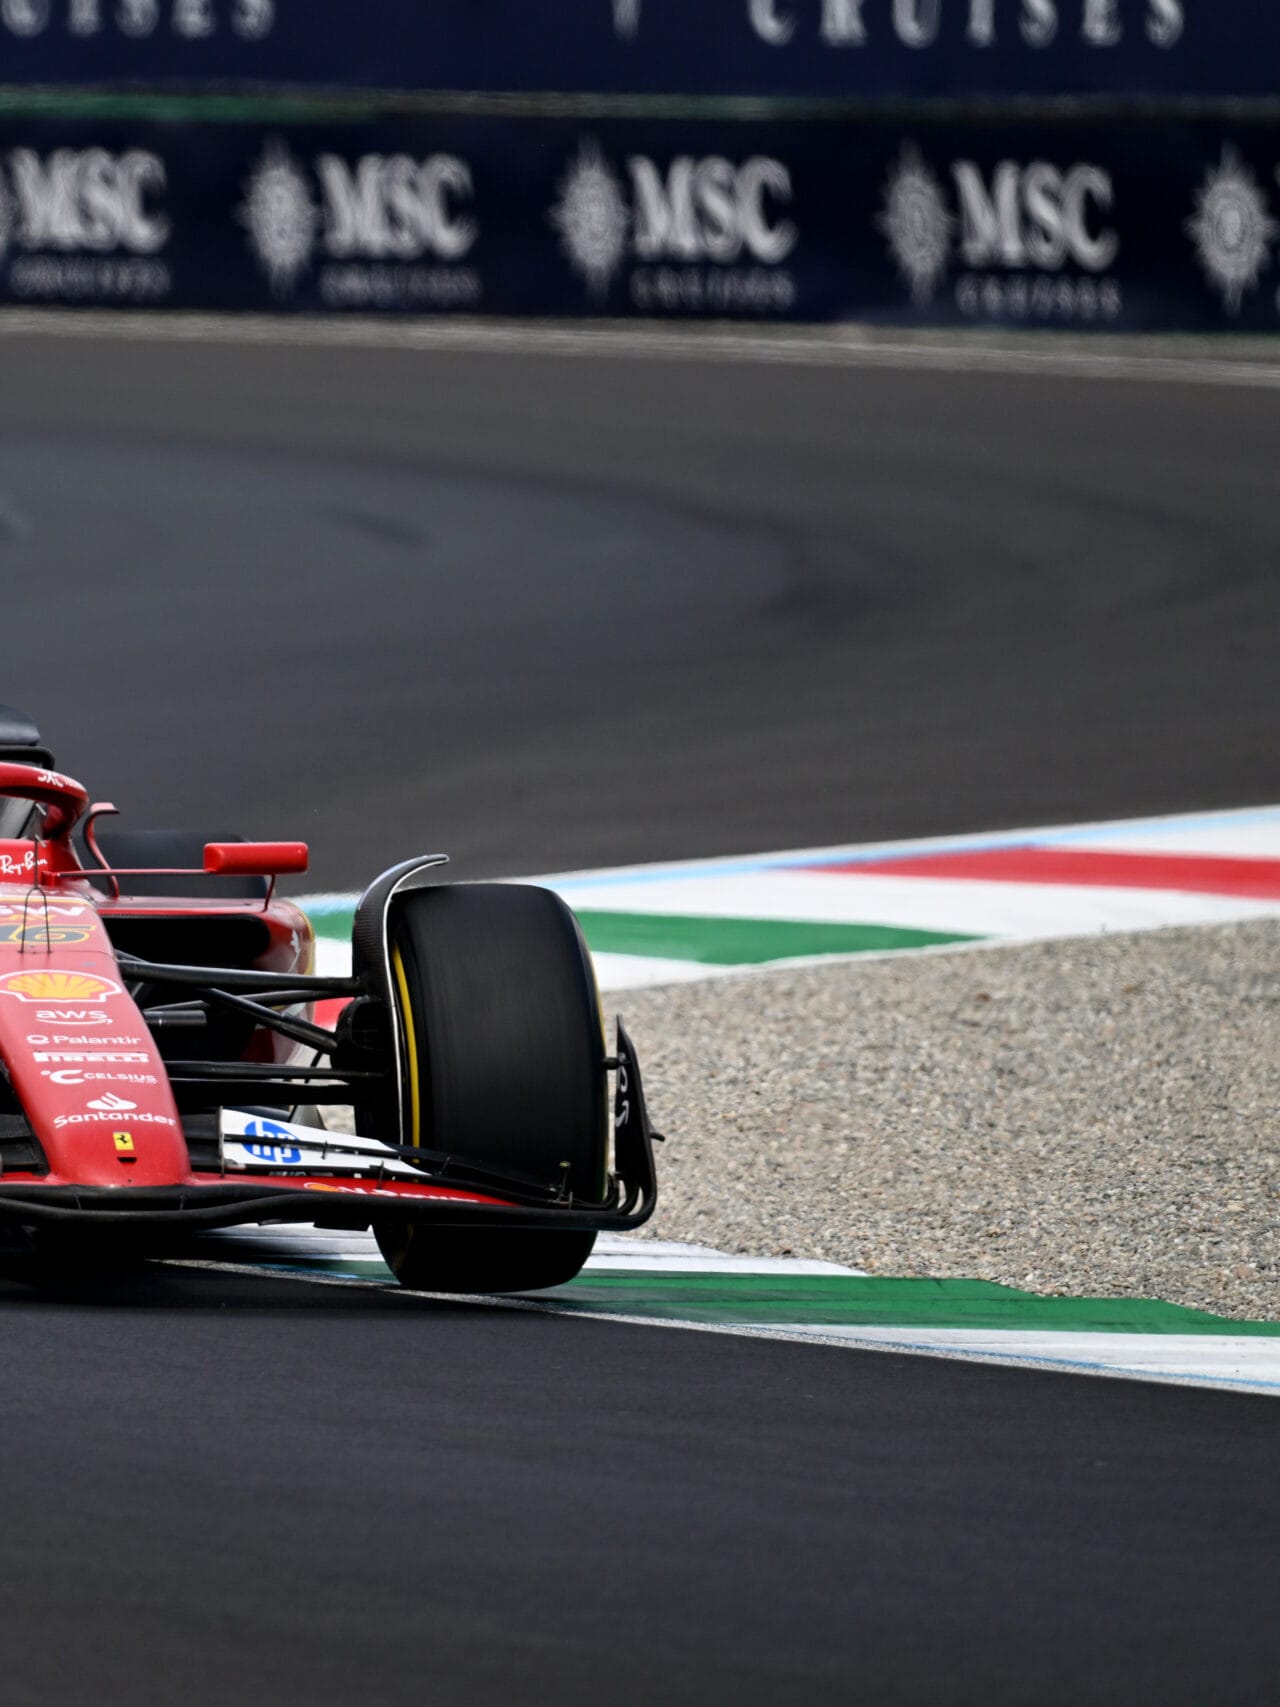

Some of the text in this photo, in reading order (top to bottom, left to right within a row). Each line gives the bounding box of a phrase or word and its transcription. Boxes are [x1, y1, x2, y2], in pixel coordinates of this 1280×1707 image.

[13, 148, 171, 252] MSC
[319, 153, 477, 258] MSC
[627, 155, 797, 263] MSC
[951, 160, 1119, 270] MSC
[35, 1010, 109, 1021] aws
[53, 1035, 142, 1045] Palantir
[32, 1052, 150, 1063] PIRELLI
[83, 1072, 158, 1083] CELSIUS
[54, 1111, 177, 1129] Santander
[245, 1119, 297, 1164] hp
